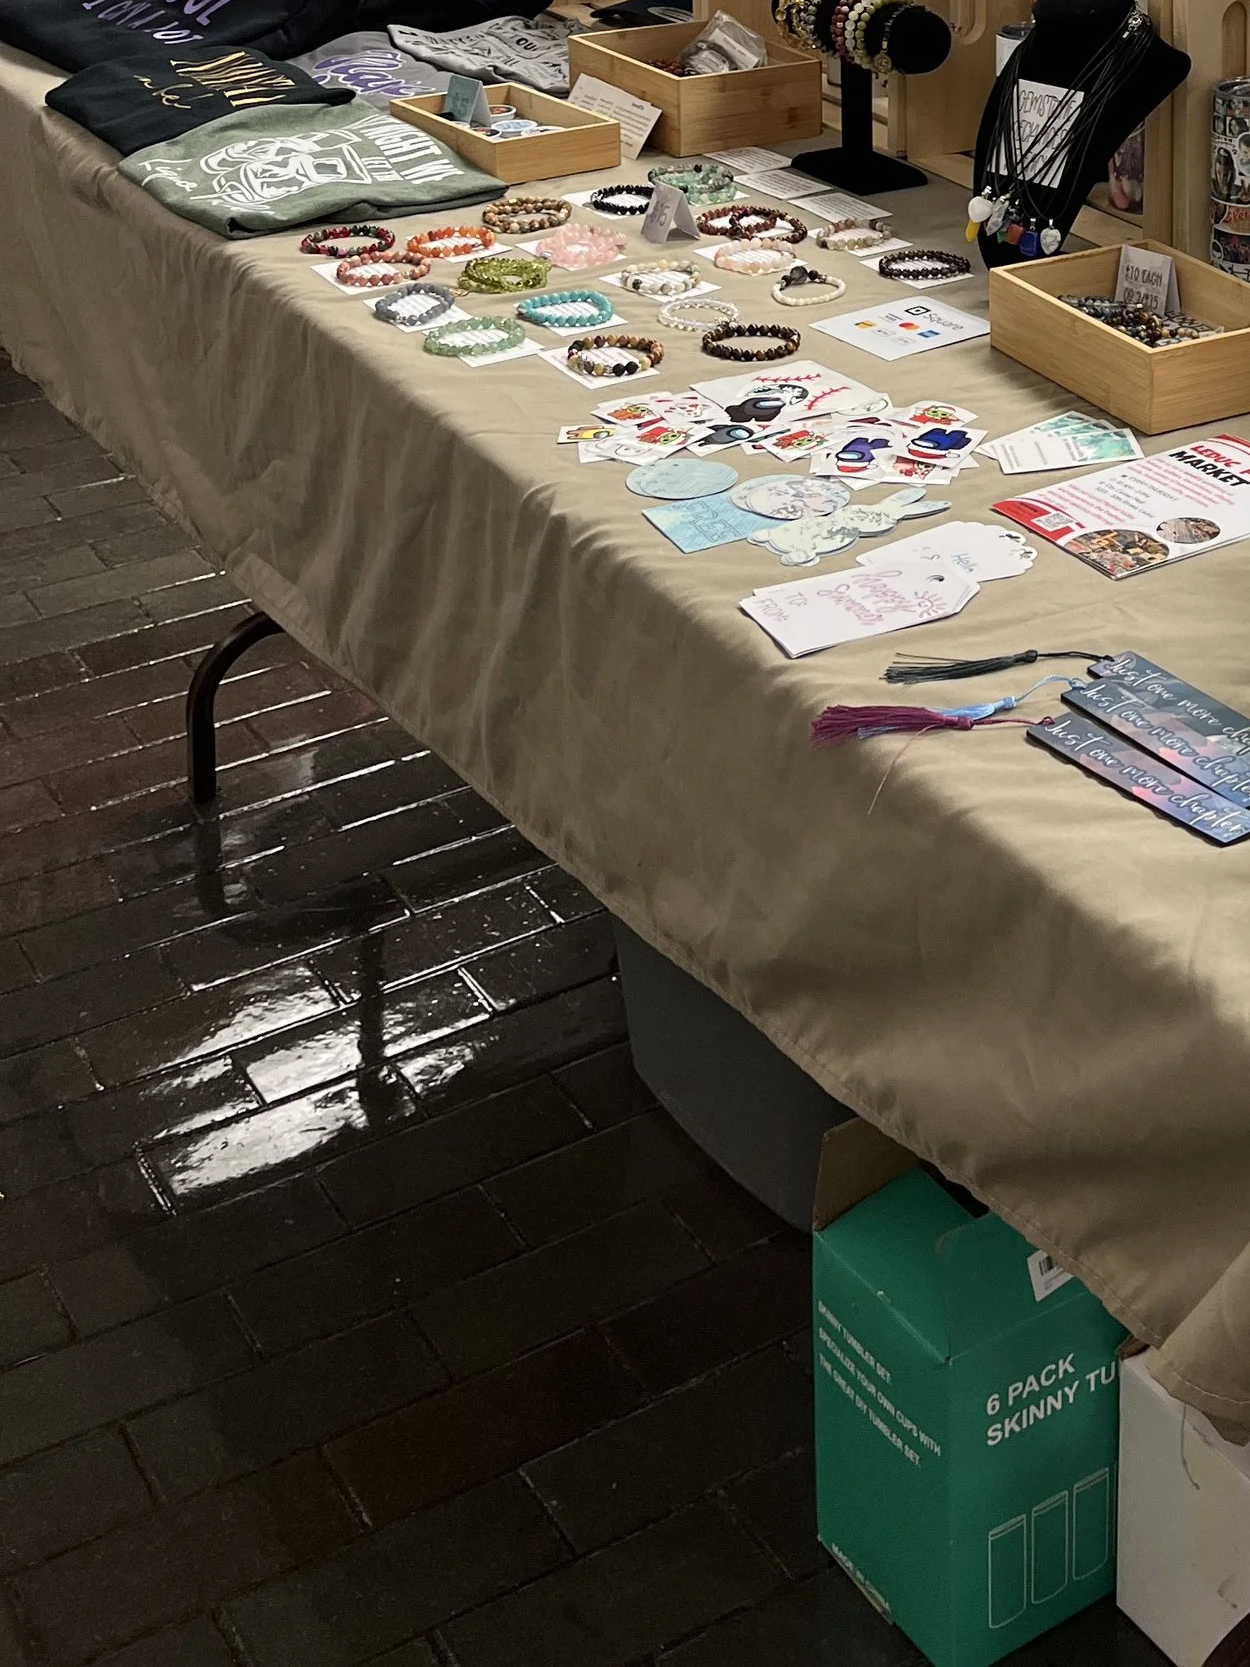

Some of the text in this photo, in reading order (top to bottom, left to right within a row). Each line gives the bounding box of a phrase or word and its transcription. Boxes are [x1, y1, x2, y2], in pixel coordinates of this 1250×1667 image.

[922, 312, 965, 332] Square
[1189, 444, 1244, 469] LEDUC
[1147, 683, 1178, 703] one
[1177, 697, 1223, 729] more
[1120, 708, 1152, 731] one
[1151, 722, 1197, 758] more
[1089, 747, 1121, 770] one
[1120, 763, 1174, 797] more
[1170, 790, 1250, 839] chapter
[986, 1352, 1076, 1416] 6 PACK
[986, 1360, 1117, 1446] SKINNY TU
[855, 1369, 877, 1397] YOUR
[877, 1391, 896, 1417] OWN
[895, 1410, 918, 1437] CUPS
[918, 1430, 942, 1457] WITH
[868, 1408, 904, 1452] TUMBLER
